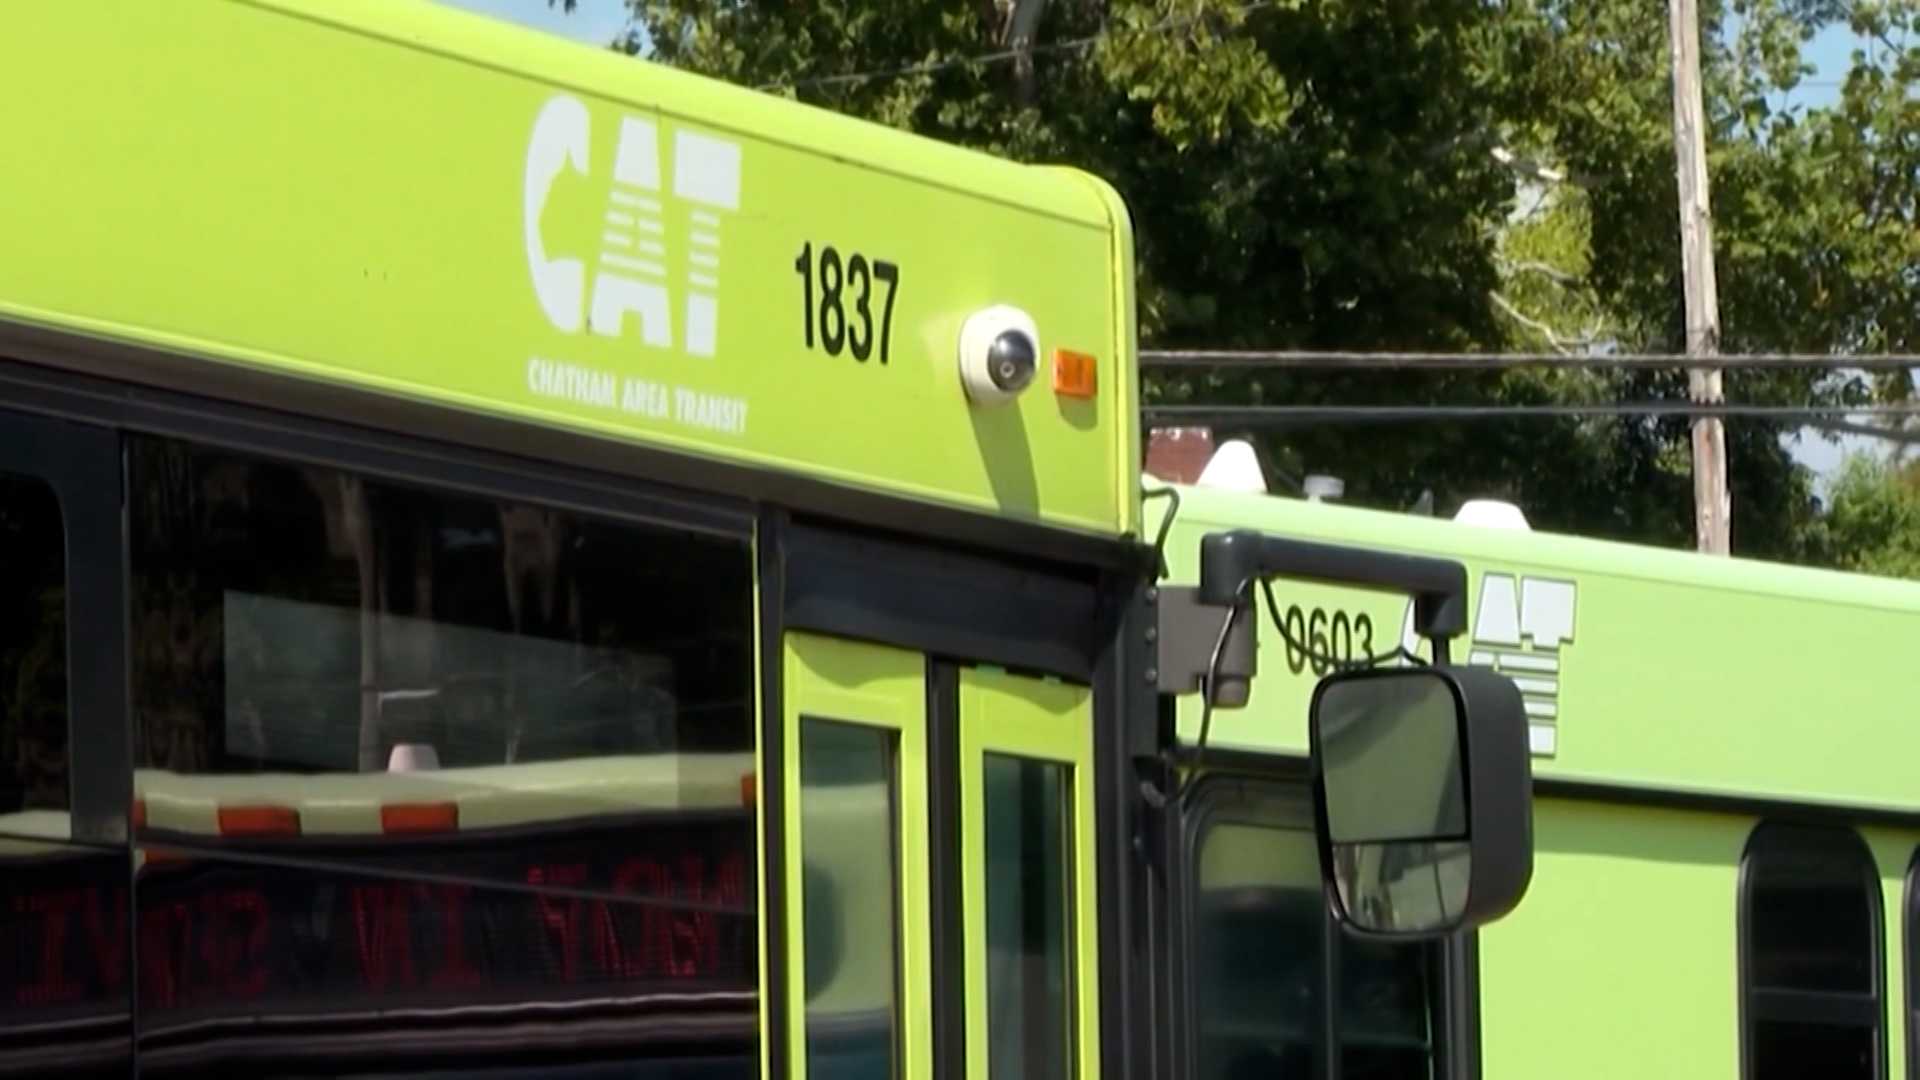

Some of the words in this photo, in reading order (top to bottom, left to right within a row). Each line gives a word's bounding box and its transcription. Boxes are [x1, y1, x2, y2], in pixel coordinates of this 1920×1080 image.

[523, 93, 742, 358] CAT
[795, 241, 899, 365] 1837
[621, 376, 669, 418] AREA
[674, 386, 748, 434] TRANSIT
[1286, 604, 1373, 675] 0603
[1401, 571, 1577, 759] AT
